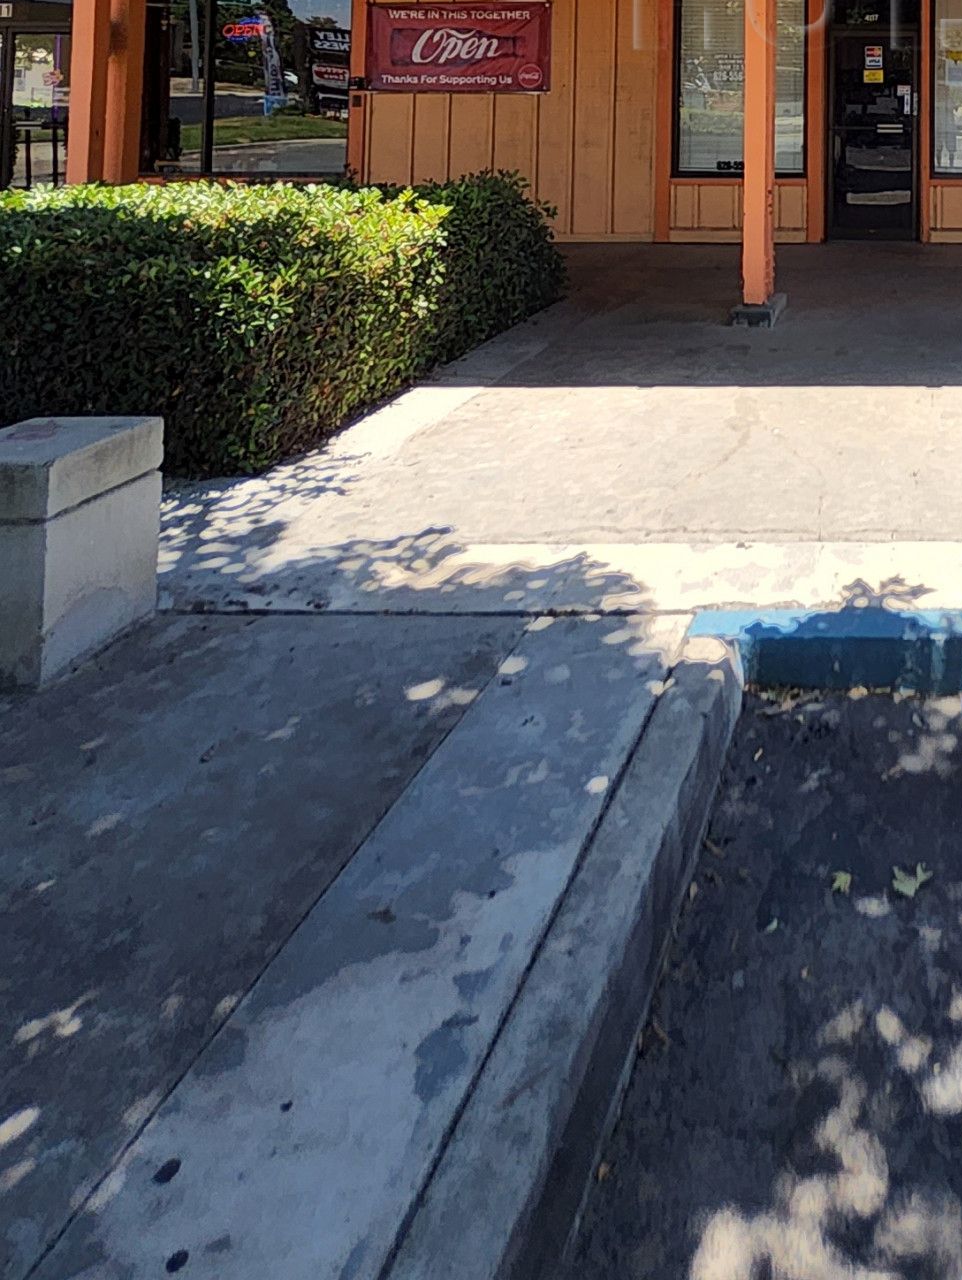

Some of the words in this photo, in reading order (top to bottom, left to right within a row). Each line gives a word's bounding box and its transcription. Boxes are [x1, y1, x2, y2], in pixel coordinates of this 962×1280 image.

[388, 9, 425, 20] WE'RE
[427, 10, 440, 20] IN
[442, 9, 468, 20] THIS
[471, 10, 531, 20] TOGETHER
[411, 28, 501, 64] Open
[381, 74, 419, 85] Thanks
[420, 75, 438, 84] For
[439, 75, 497, 86] Supporting
[498, 75, 513, 85] Us
